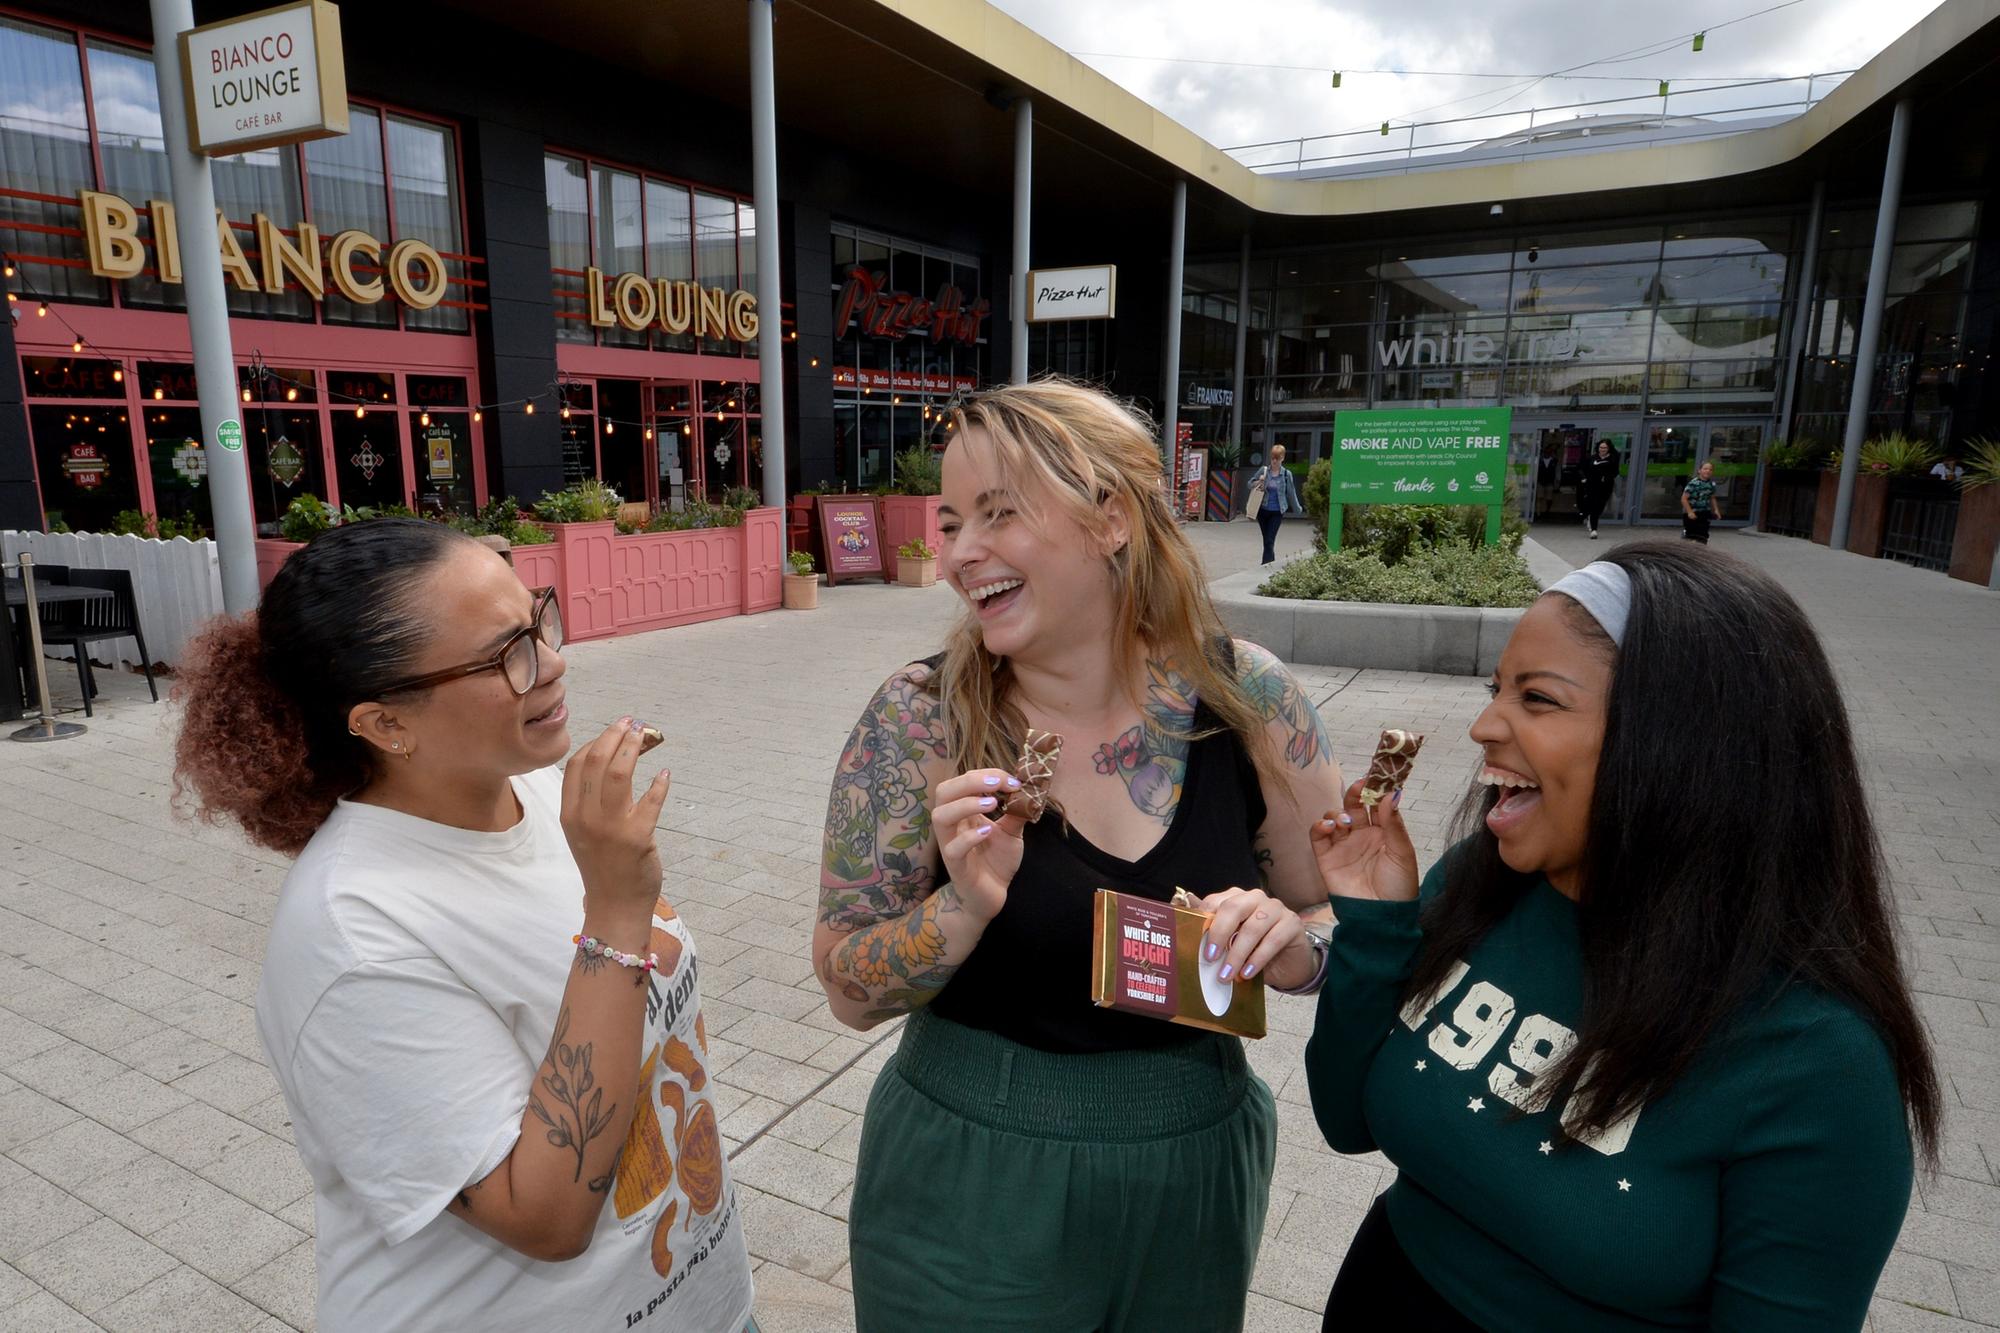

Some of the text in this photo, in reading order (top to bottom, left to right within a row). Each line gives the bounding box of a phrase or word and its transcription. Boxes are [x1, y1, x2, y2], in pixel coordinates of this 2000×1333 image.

[211, 33, 293, 74] BIANCO
[212, 67, 301, 108] LOUNGE
[235, 111, 283, 131] CAFÉ BAR
[81, 189, 448, 311] BIANCO
[587, 266, 759, 342] LOUNG
[833, 263, 993, 348] Pizza Hut
[1037, 285, 1106, 304] Pizza Hut
[1377, 328, 1496, 367] white
[1340, 436, 1500, 450] SMOKE AND VAPE FREE
[1393, 477, 1436, 493] thanks
[1123, 925, 1171, 948] WHITE ROSE
[1123, 938, 1171, 967] DELIGHT
[664, 951, 698, 1033] dent
[1127, 970, 1167, 987] HAND-CRAFTED
[625, 1309, 643, 1329] la
[646, 1271, 685, 1318] pasta
